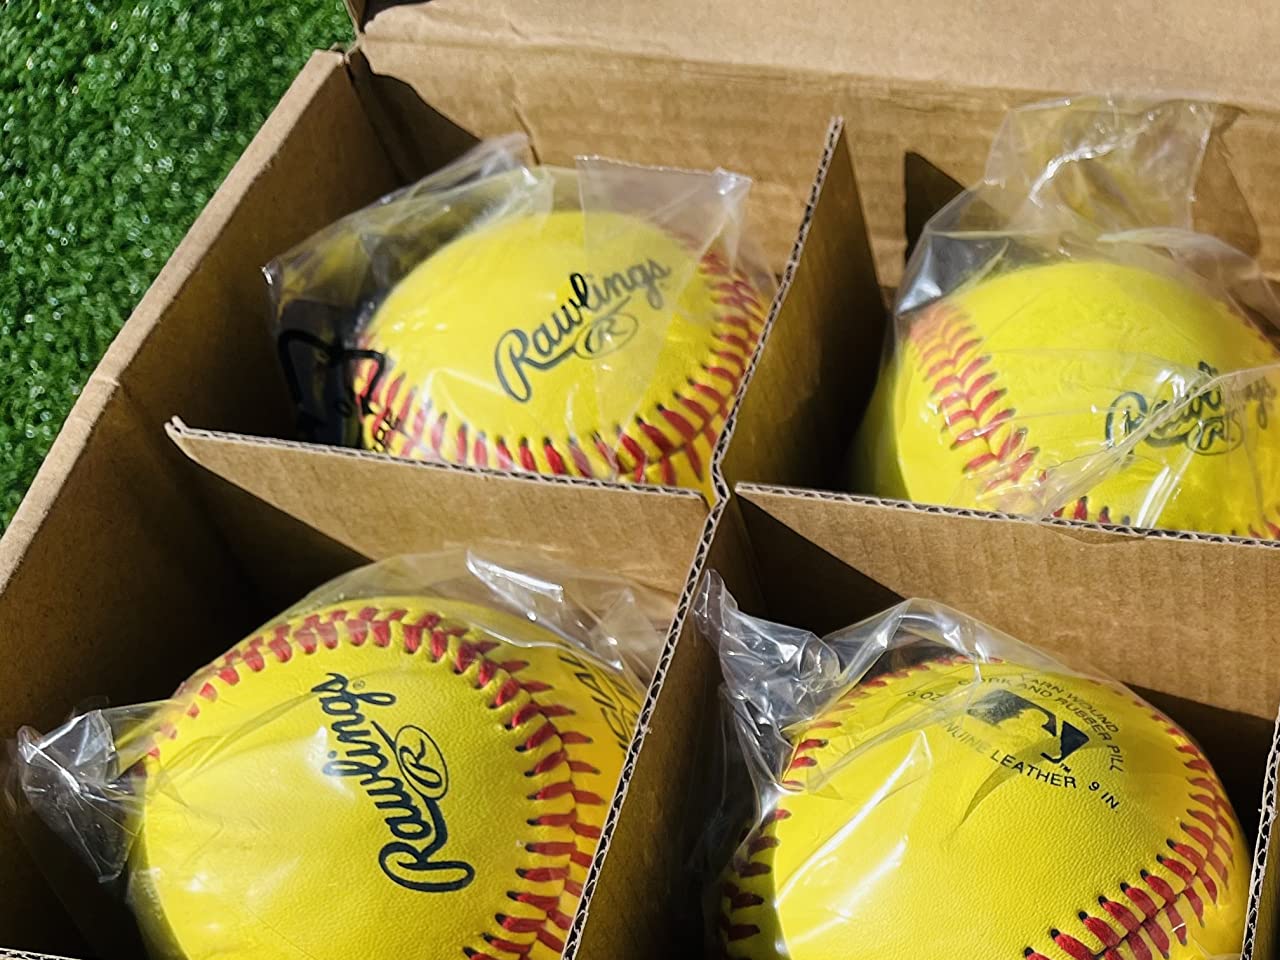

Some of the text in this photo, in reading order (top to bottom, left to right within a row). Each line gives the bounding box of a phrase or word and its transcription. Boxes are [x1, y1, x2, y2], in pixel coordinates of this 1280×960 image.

[494, 258, 672, 403] Rawlings
[1055, 697, 1113, 742] RUBBER
[1107, 743, 1124, 773] PILL
[1067, 693, 1120, 733] WOUND
[311, 672, 476, 893] Rawlings
[990, 749, 1078, 790] LEATHER
[1088, 781, 1101, 792] 9
